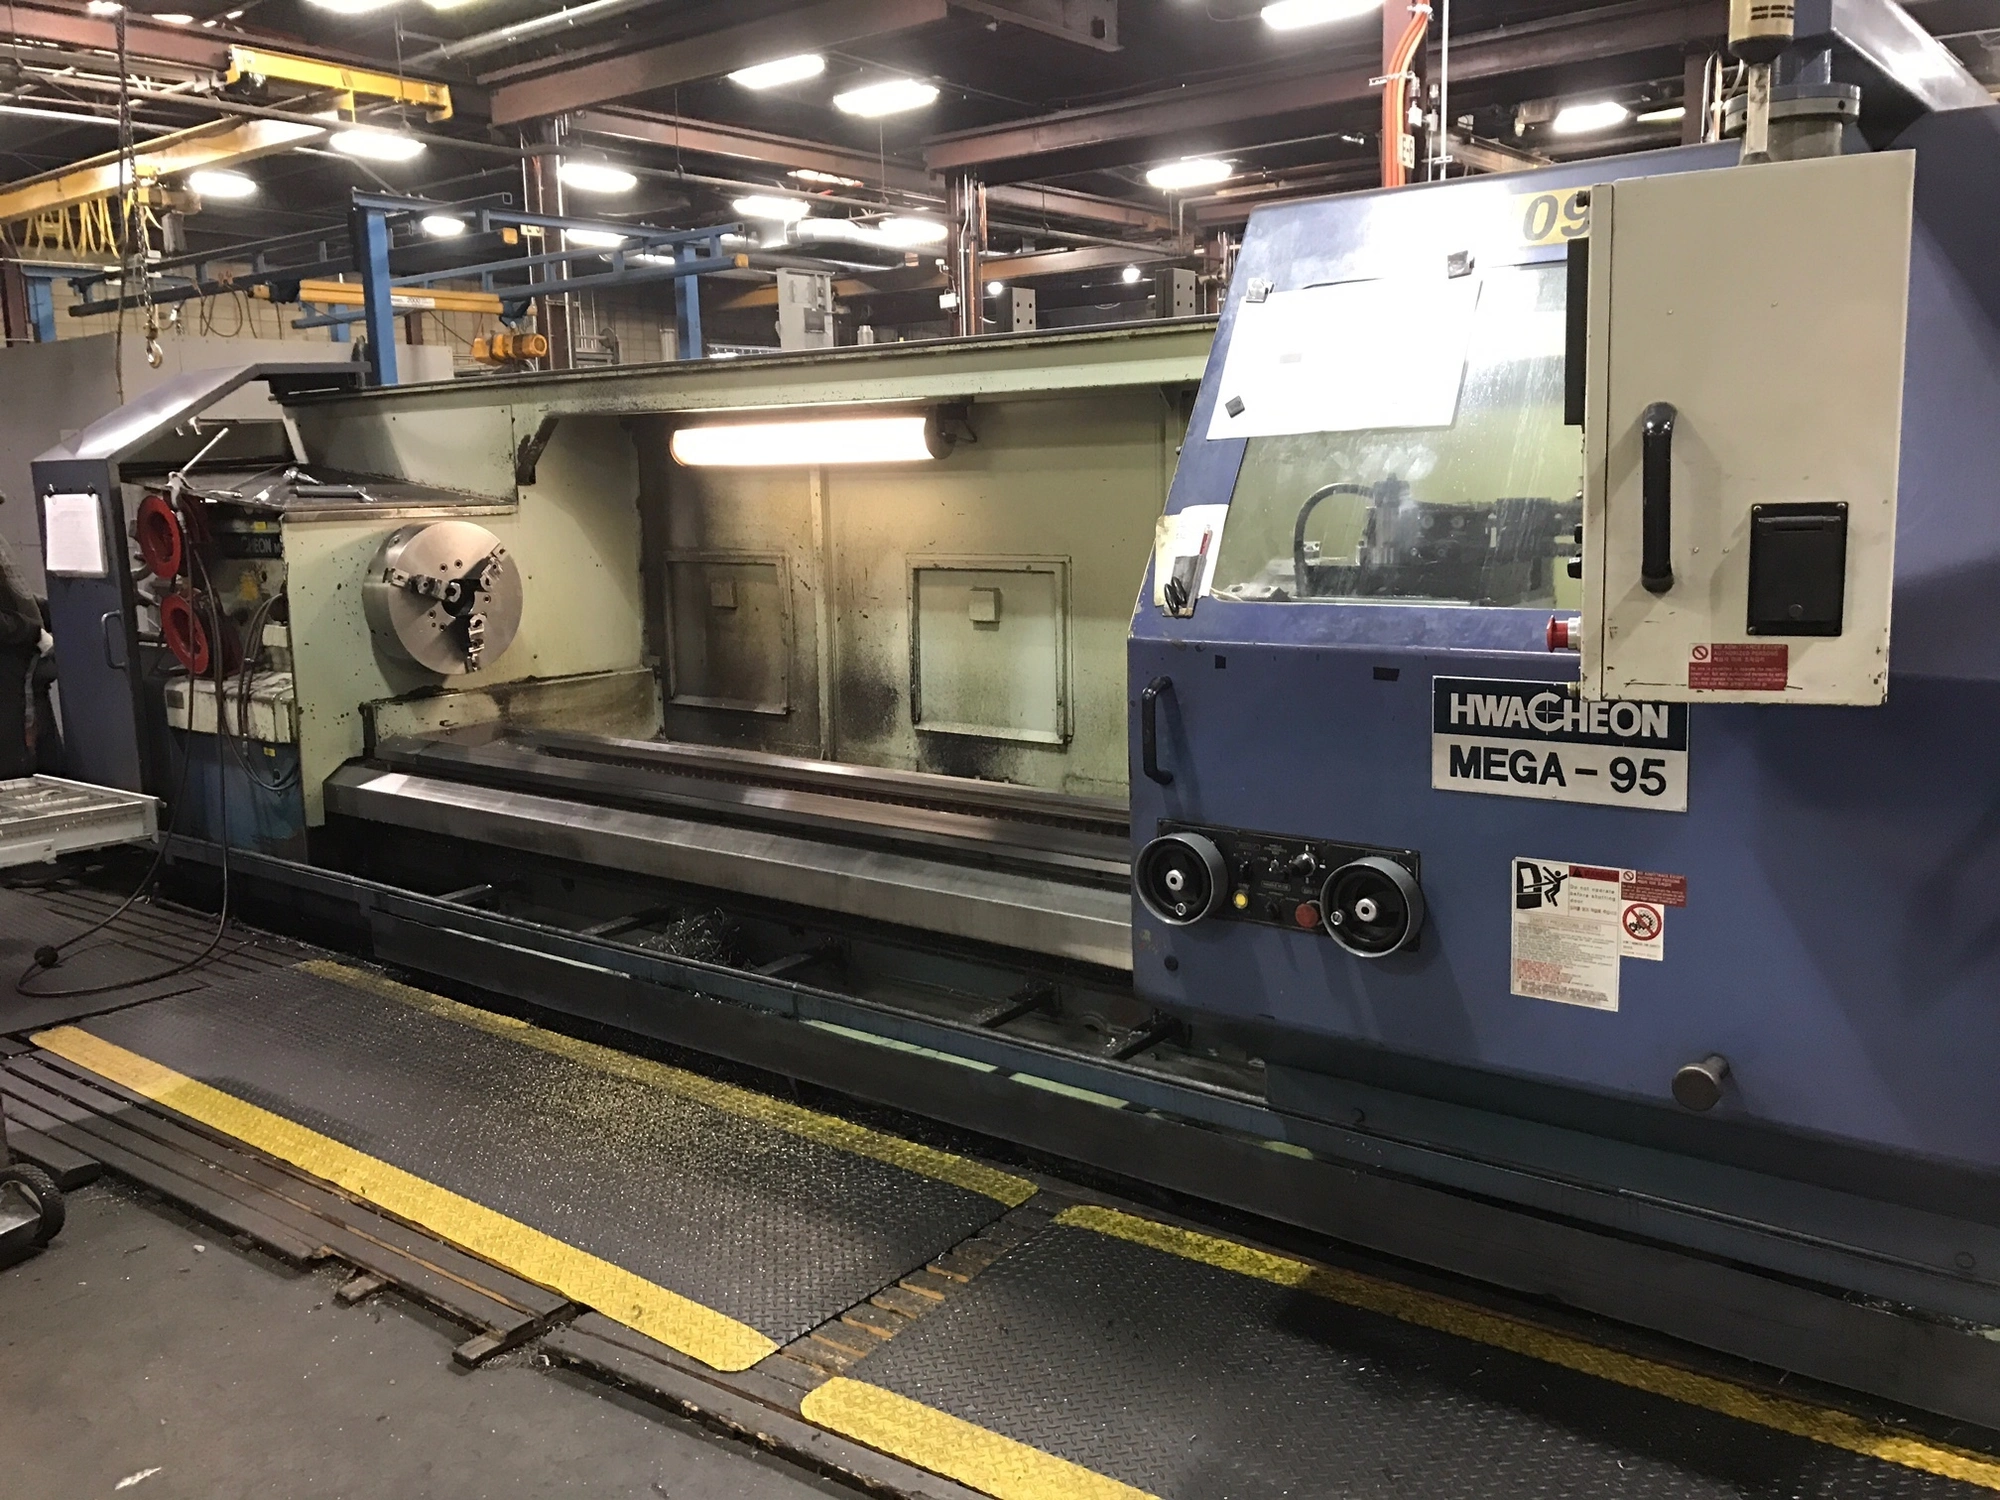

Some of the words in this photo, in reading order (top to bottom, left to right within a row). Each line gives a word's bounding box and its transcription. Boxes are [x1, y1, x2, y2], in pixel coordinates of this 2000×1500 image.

[1450, 691, 1669, 739] HWACHEON
[1450, 744, 1567, 788] MEGA
[1609, 756, 1667, 797] 95
[1591, 894, 1616, 902] shutting
